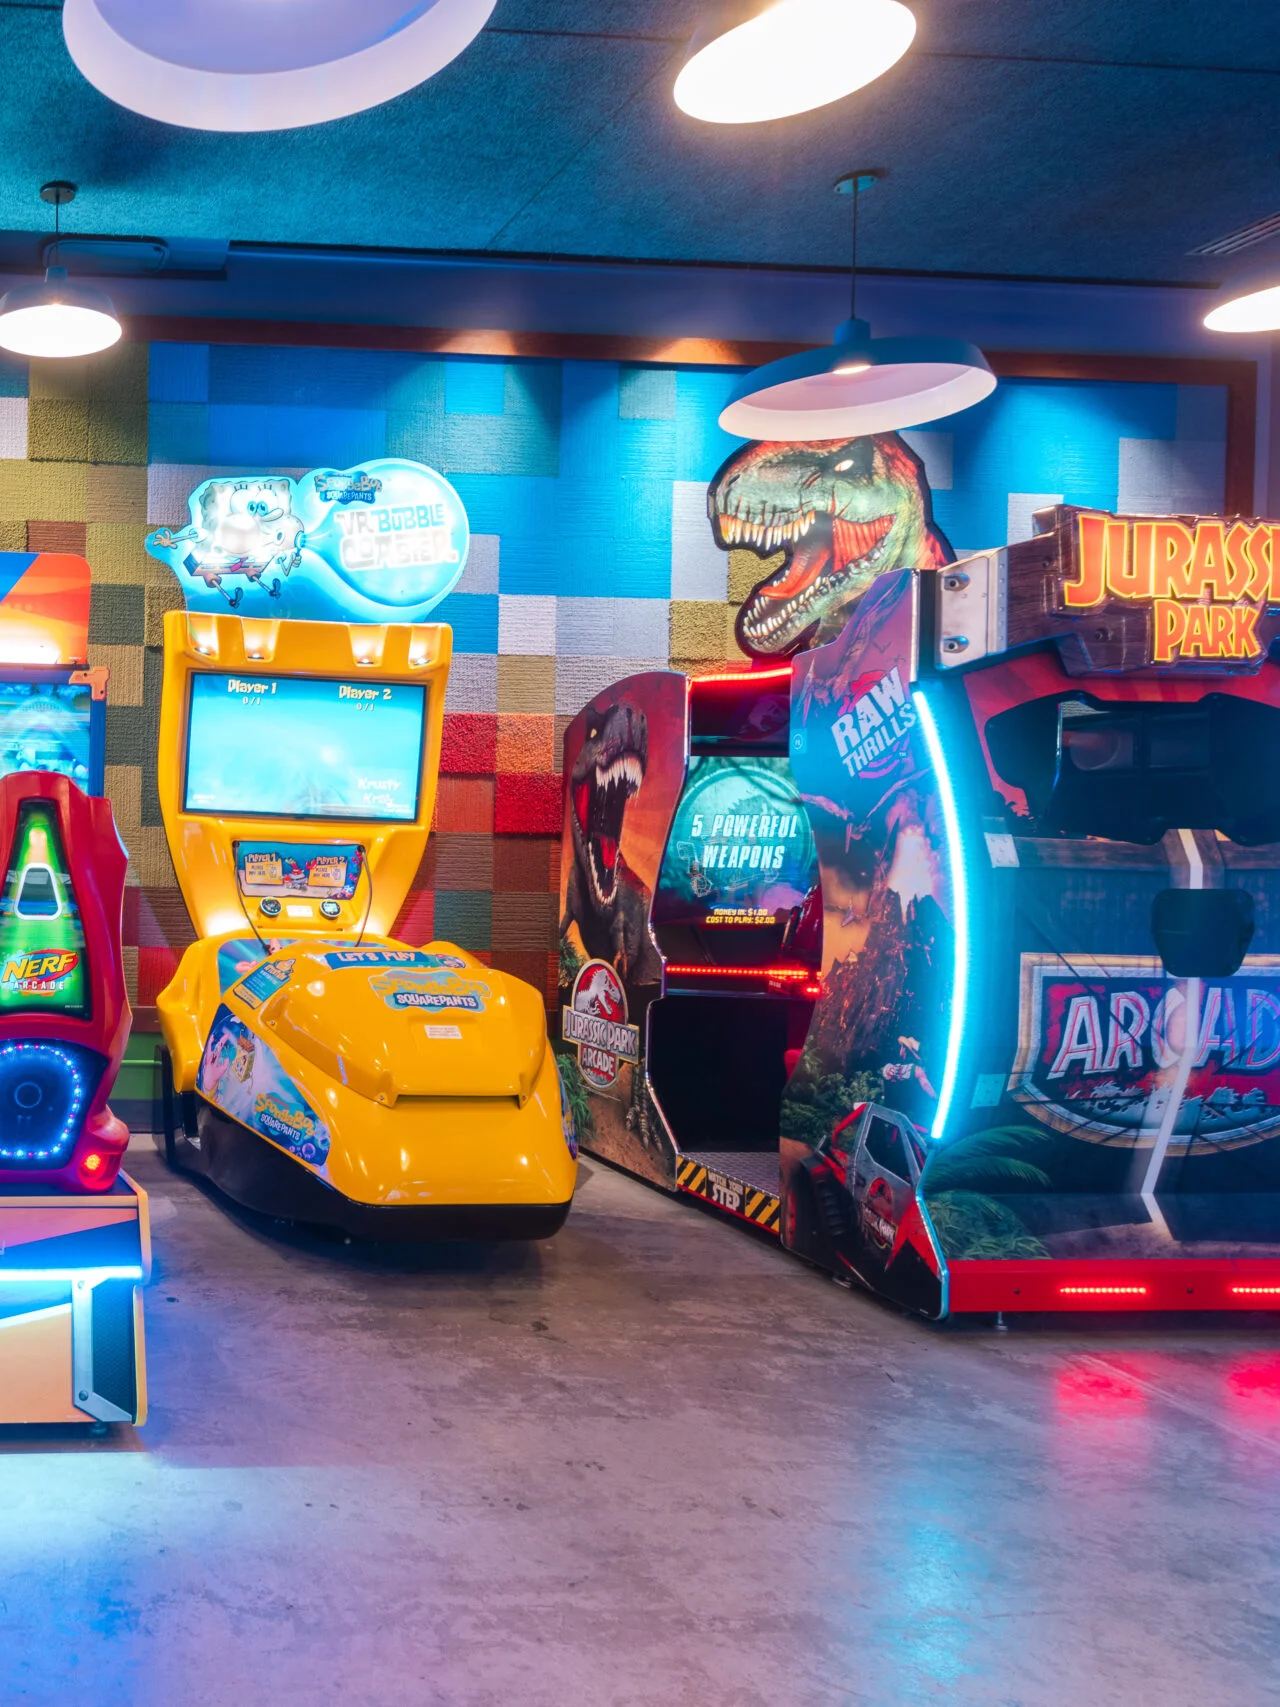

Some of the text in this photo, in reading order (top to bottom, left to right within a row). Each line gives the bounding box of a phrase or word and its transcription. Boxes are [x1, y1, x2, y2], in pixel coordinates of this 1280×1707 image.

[336, 503, 445, 535] VR BUBBLE
[341, 530, 457, 570] COASTER
[1153, 598, 1262, 662] PARK
[227, 679, 277, 694] Player 1
[339, 685, 392, 700] Player 2
[831, 666, 905, 758] RAW
[842, 703, 916, 777] THRILLS
[691, 814, 798, 838] 5 POWERFUL
[248, 854, 270, 863] PLAYER
[317, 856, 338, 865] PLAYER
[702, 845, 785, 869] WEAPONS
[706, 916, 776, 925] COST TO PLAY: $2.00
[713, 908, 736, 916] MONEY
[1, 952, 77, 983] NERF
[336, 952, 415, 962] LET'S PLAY
[14, 981, 64, 990] ARCADE
[396, 993, 477, 1007] SQUAREPANTS
[564, 1010, 637, 1055] JURASSIC PARK
[581, 1047, 615, 1077] ARCADE
[260, 1113, 301, 1141] SQUAREPANTS
[712, 1183, 740, 1211] STEP
